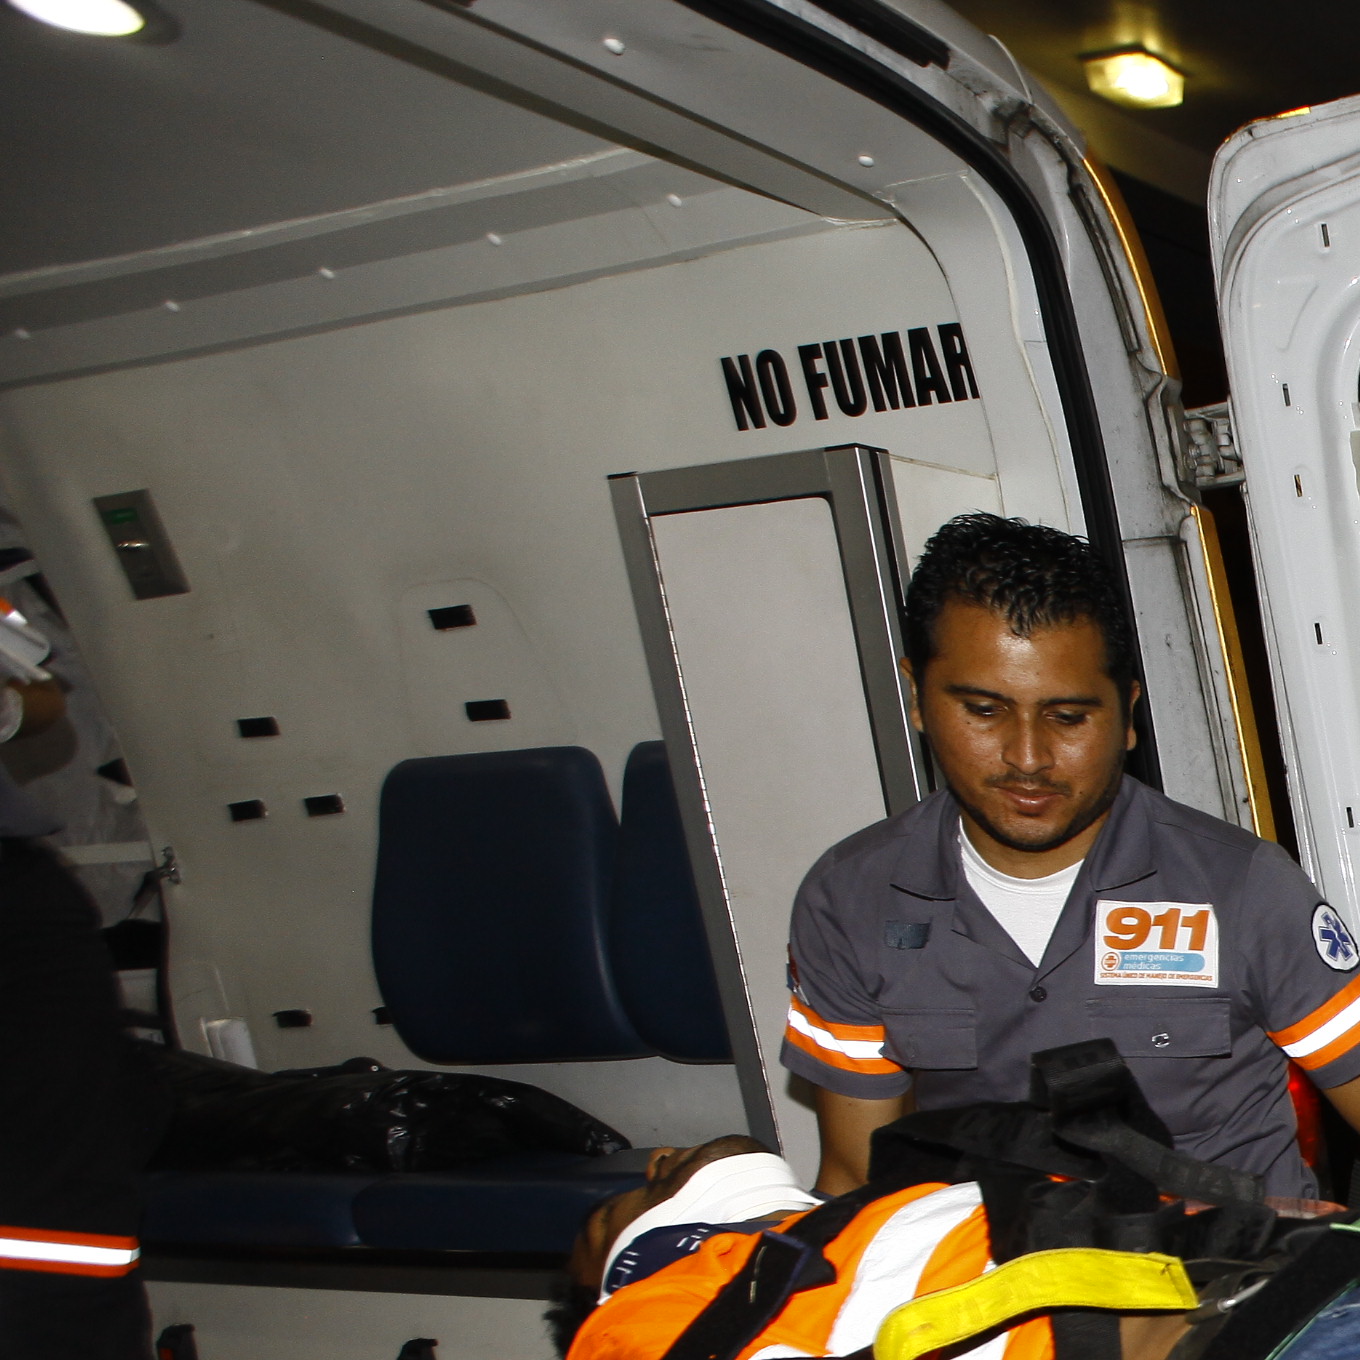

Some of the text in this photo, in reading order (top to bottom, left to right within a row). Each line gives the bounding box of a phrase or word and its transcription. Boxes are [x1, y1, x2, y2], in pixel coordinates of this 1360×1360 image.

[720, 322, 981, 431] NO FUMAR
[1103, 906, 1210, 951] 911
[1122, 961, 1161, 970] médicas
[1124, 953, 1185, 962] emergencias
